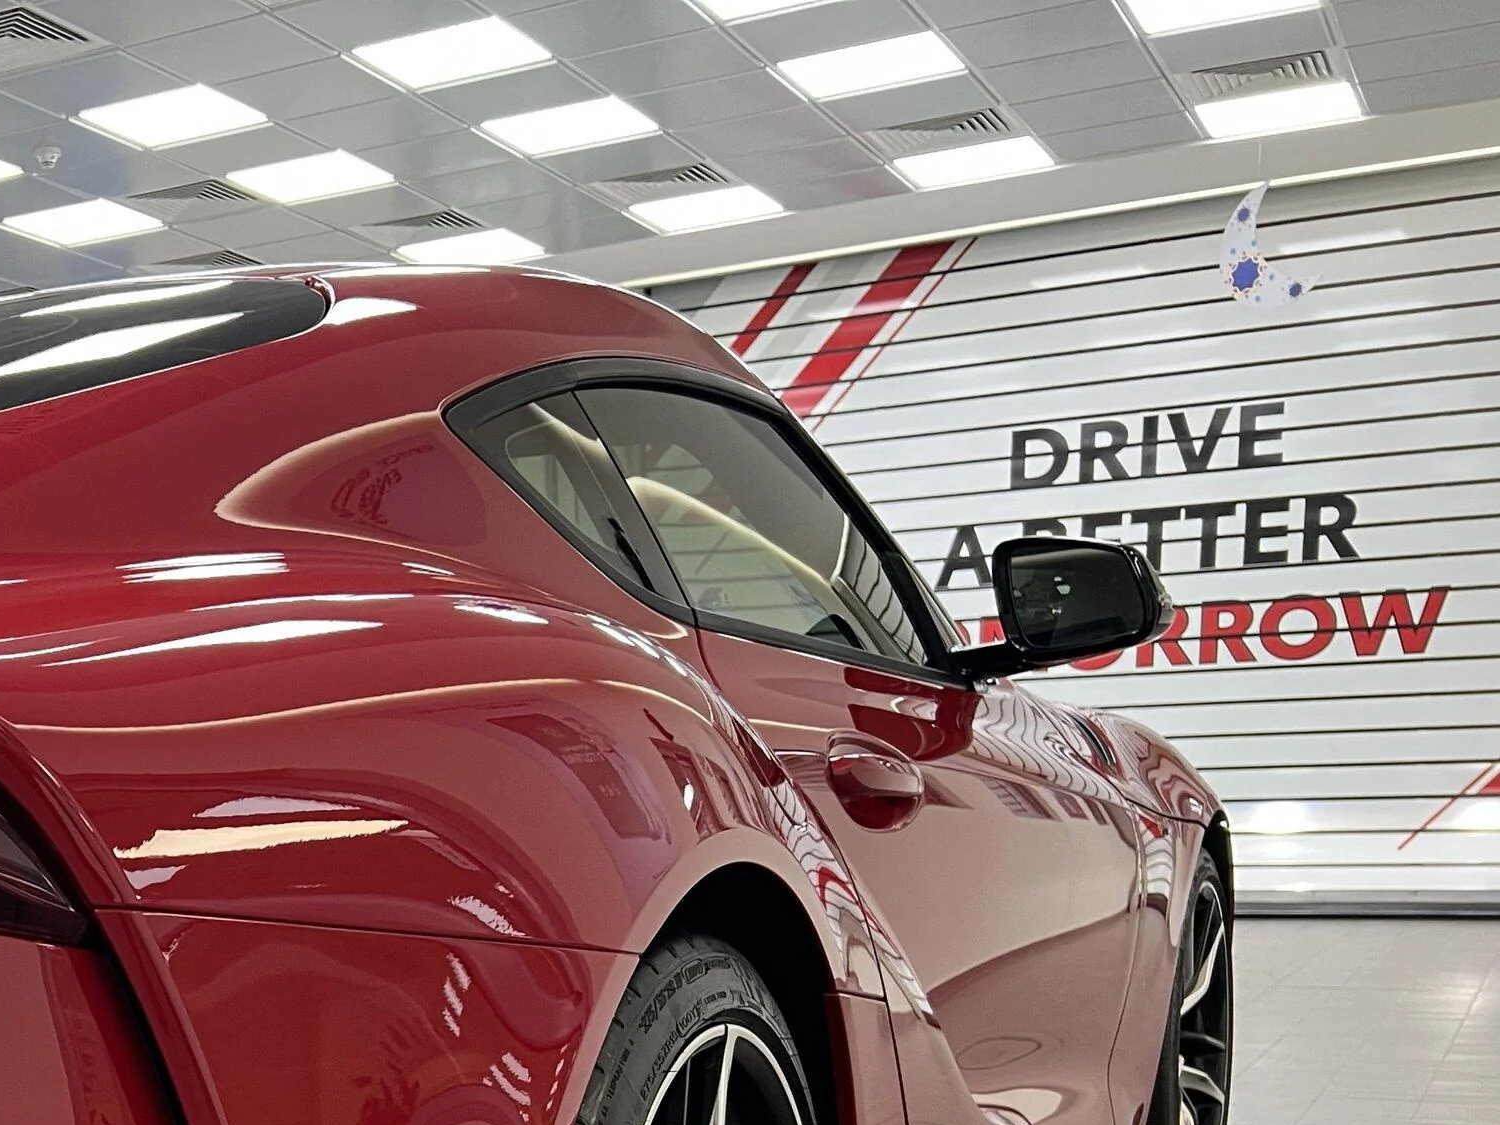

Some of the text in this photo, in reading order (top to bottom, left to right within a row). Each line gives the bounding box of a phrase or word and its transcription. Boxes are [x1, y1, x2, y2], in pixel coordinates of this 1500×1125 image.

[1010, 401, 1286, 491] DRIVE
[935, 492, 1361, 590] A TTER
